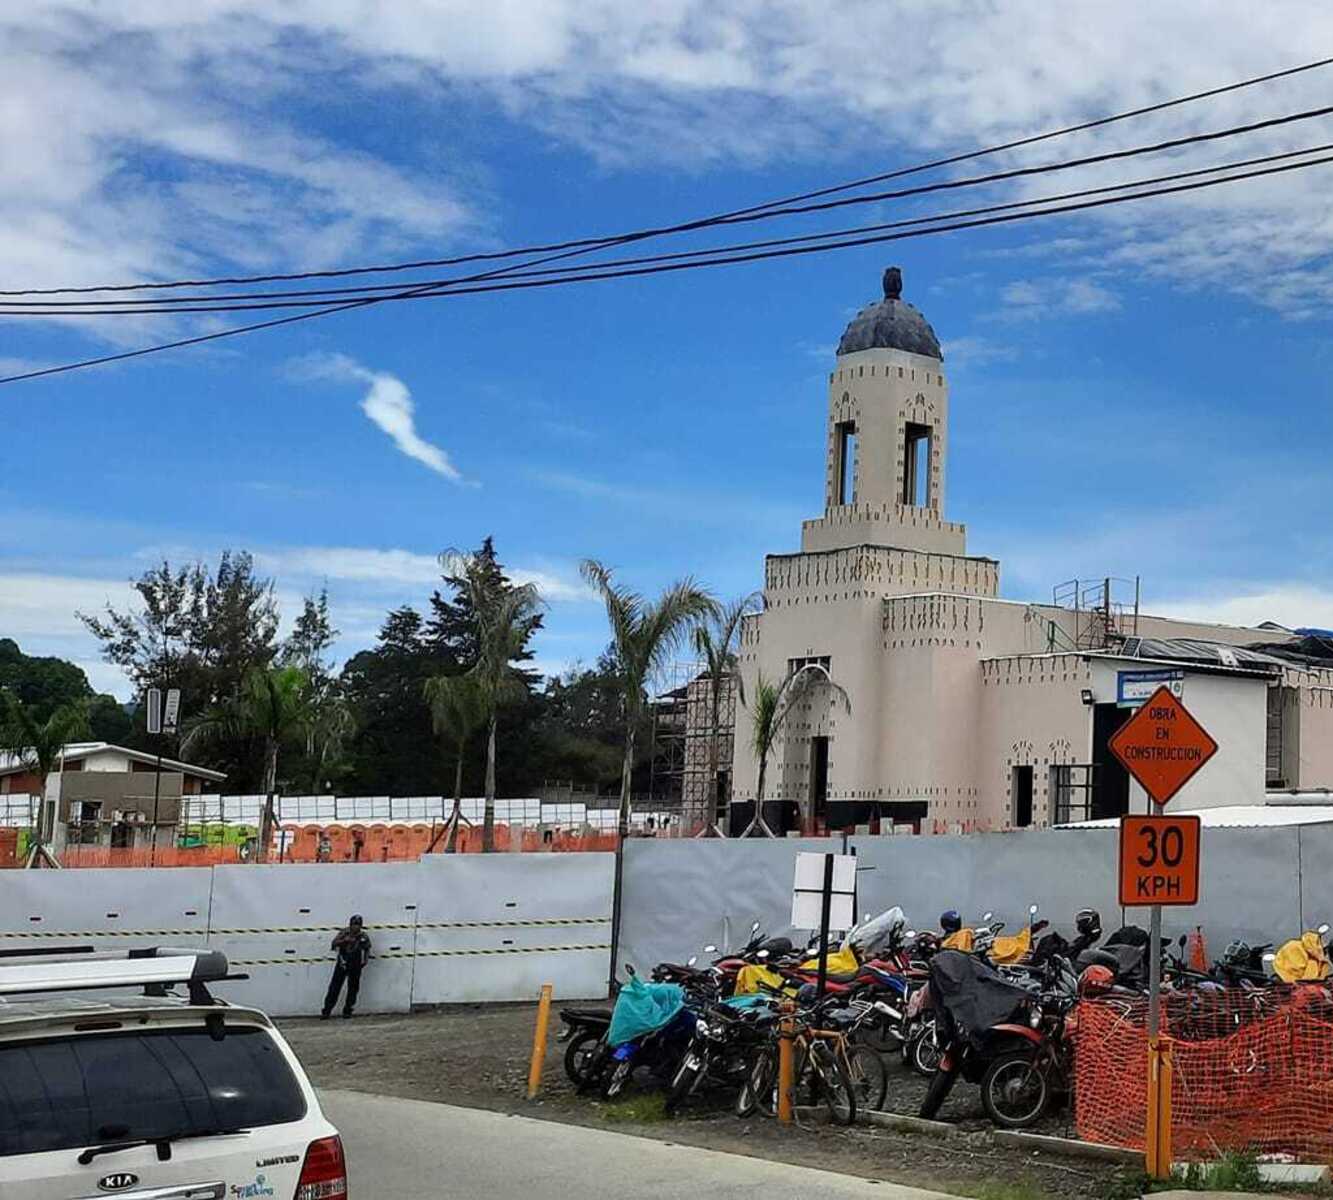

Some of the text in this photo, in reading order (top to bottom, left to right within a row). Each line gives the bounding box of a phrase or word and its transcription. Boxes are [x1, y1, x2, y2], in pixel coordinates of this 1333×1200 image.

[1149, 707, 1177, 720] OBRA
[1156, 727, 1169, 740] EN
[1124, 745, 1201, 761] CONSTRUCCION
[1137, 825, 1184, 868] 30
[1137, 875, 1180, 897] KPH
[256, 1155, 300, 1168] LIMITED
[106, 1175, 132, 1187] KIA
